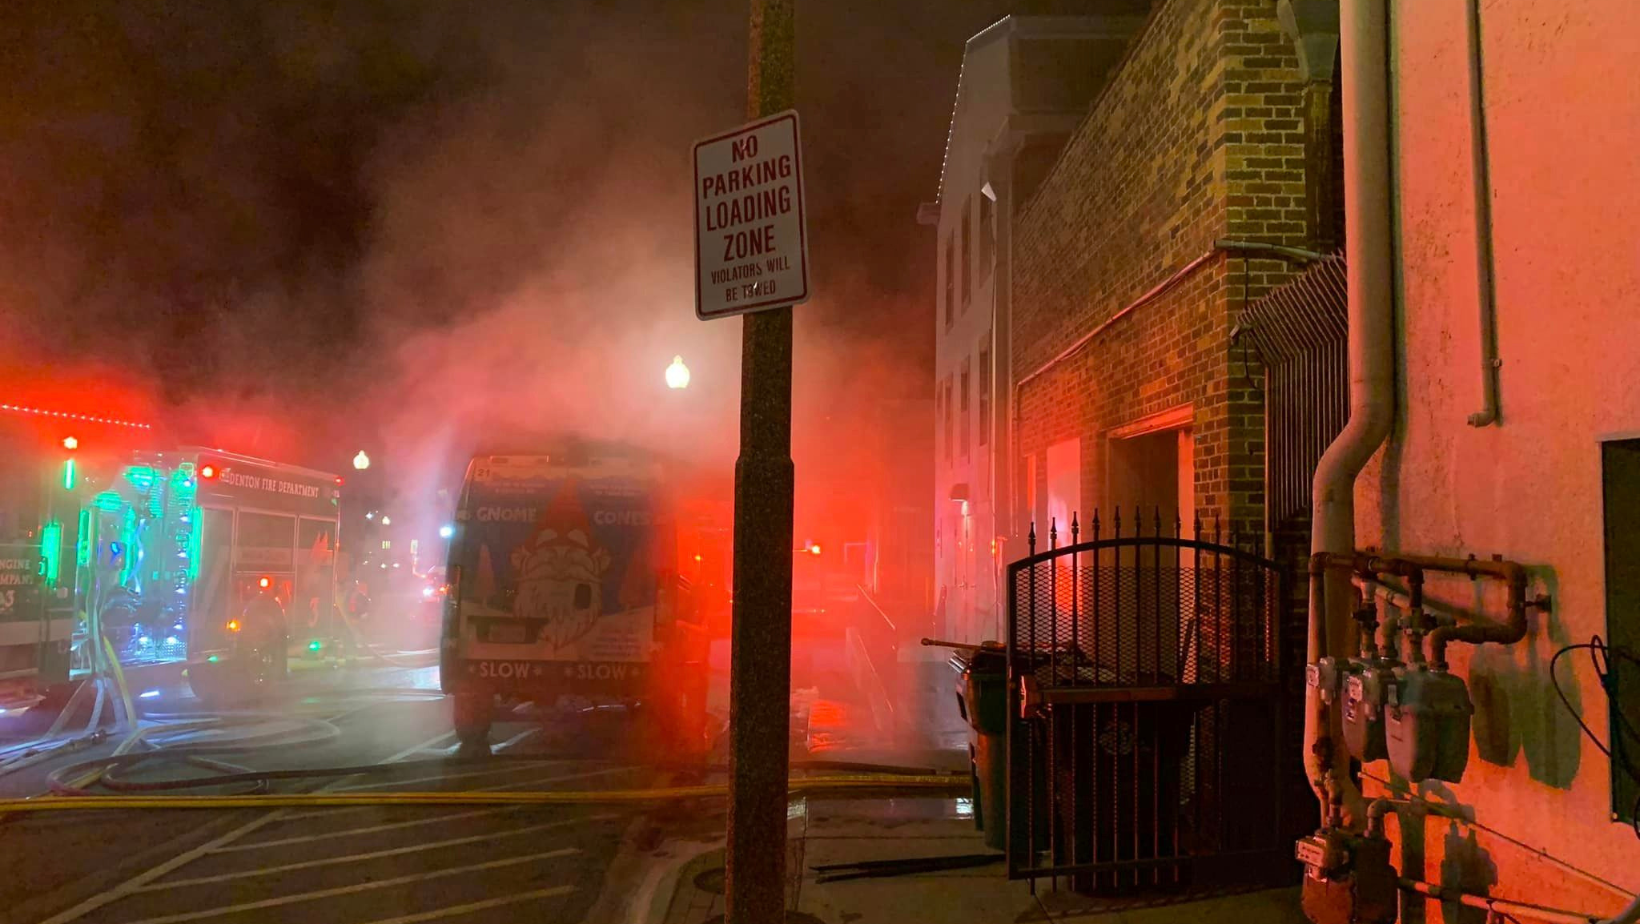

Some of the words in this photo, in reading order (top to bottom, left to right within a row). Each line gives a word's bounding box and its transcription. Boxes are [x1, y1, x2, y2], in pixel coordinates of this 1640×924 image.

[731, 135, 758, 163] NO
[702, 154, 791, 199] PARKING
[706, 185, 791, 231] LOADING
[723, 224, 776, 262] ZONE
[711, 262, 762, 284] VIOLATORS
[766, 256, 790, 274] WILL
[726, 287, 738, 302] BE
[230, 473, 260, 489] DENTON
[262, 478, 276, 492] FIRE
[278, 481, 319, 498] DEPARTMENT
[476, 506, 537, 523] GNOME
[0, 558, 30, 570] NGINE
[480, 662, 531, 678] SLOW
[577, 664, 628, 680] SLOW
